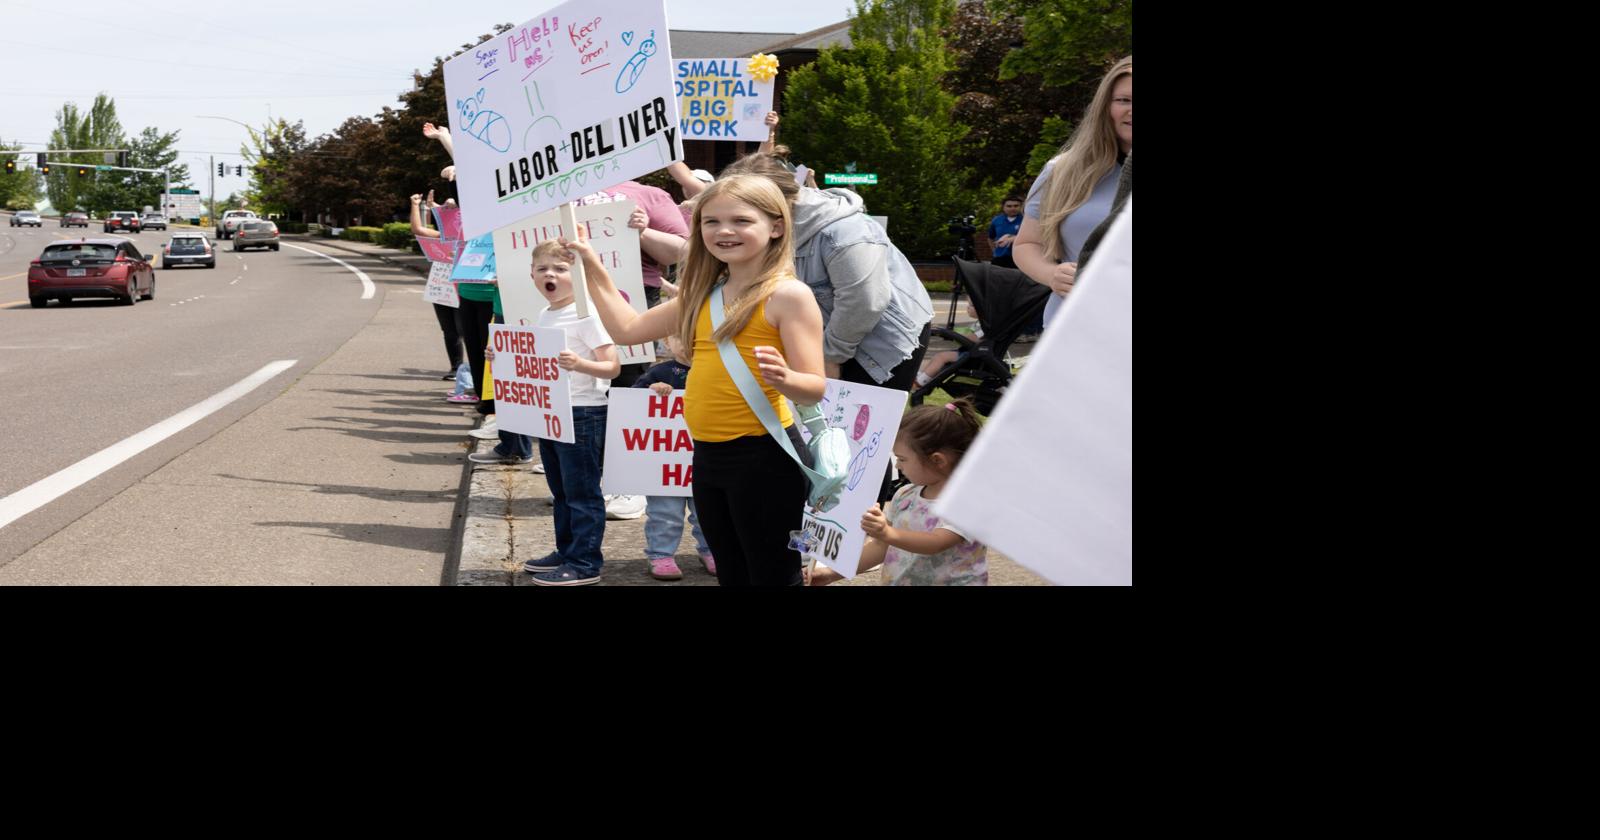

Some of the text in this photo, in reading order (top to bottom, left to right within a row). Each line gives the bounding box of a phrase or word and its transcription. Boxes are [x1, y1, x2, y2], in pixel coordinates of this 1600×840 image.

[678, 60, 742, 78] SMALL
[674, 80, 758, 97] OSPITAL
[689, 100, 726, 117] BIG
[495, 144, 559, 198] LABOR
[493, 330, 535, 355] OTHER
[514, 355, 559, 381] BABIES
[494, 379, 552, 409] DESERVE
[543, 413, 562, 438] TO
[622, 428, 695, 453] WHA
[824, 528, 843, 560] US
